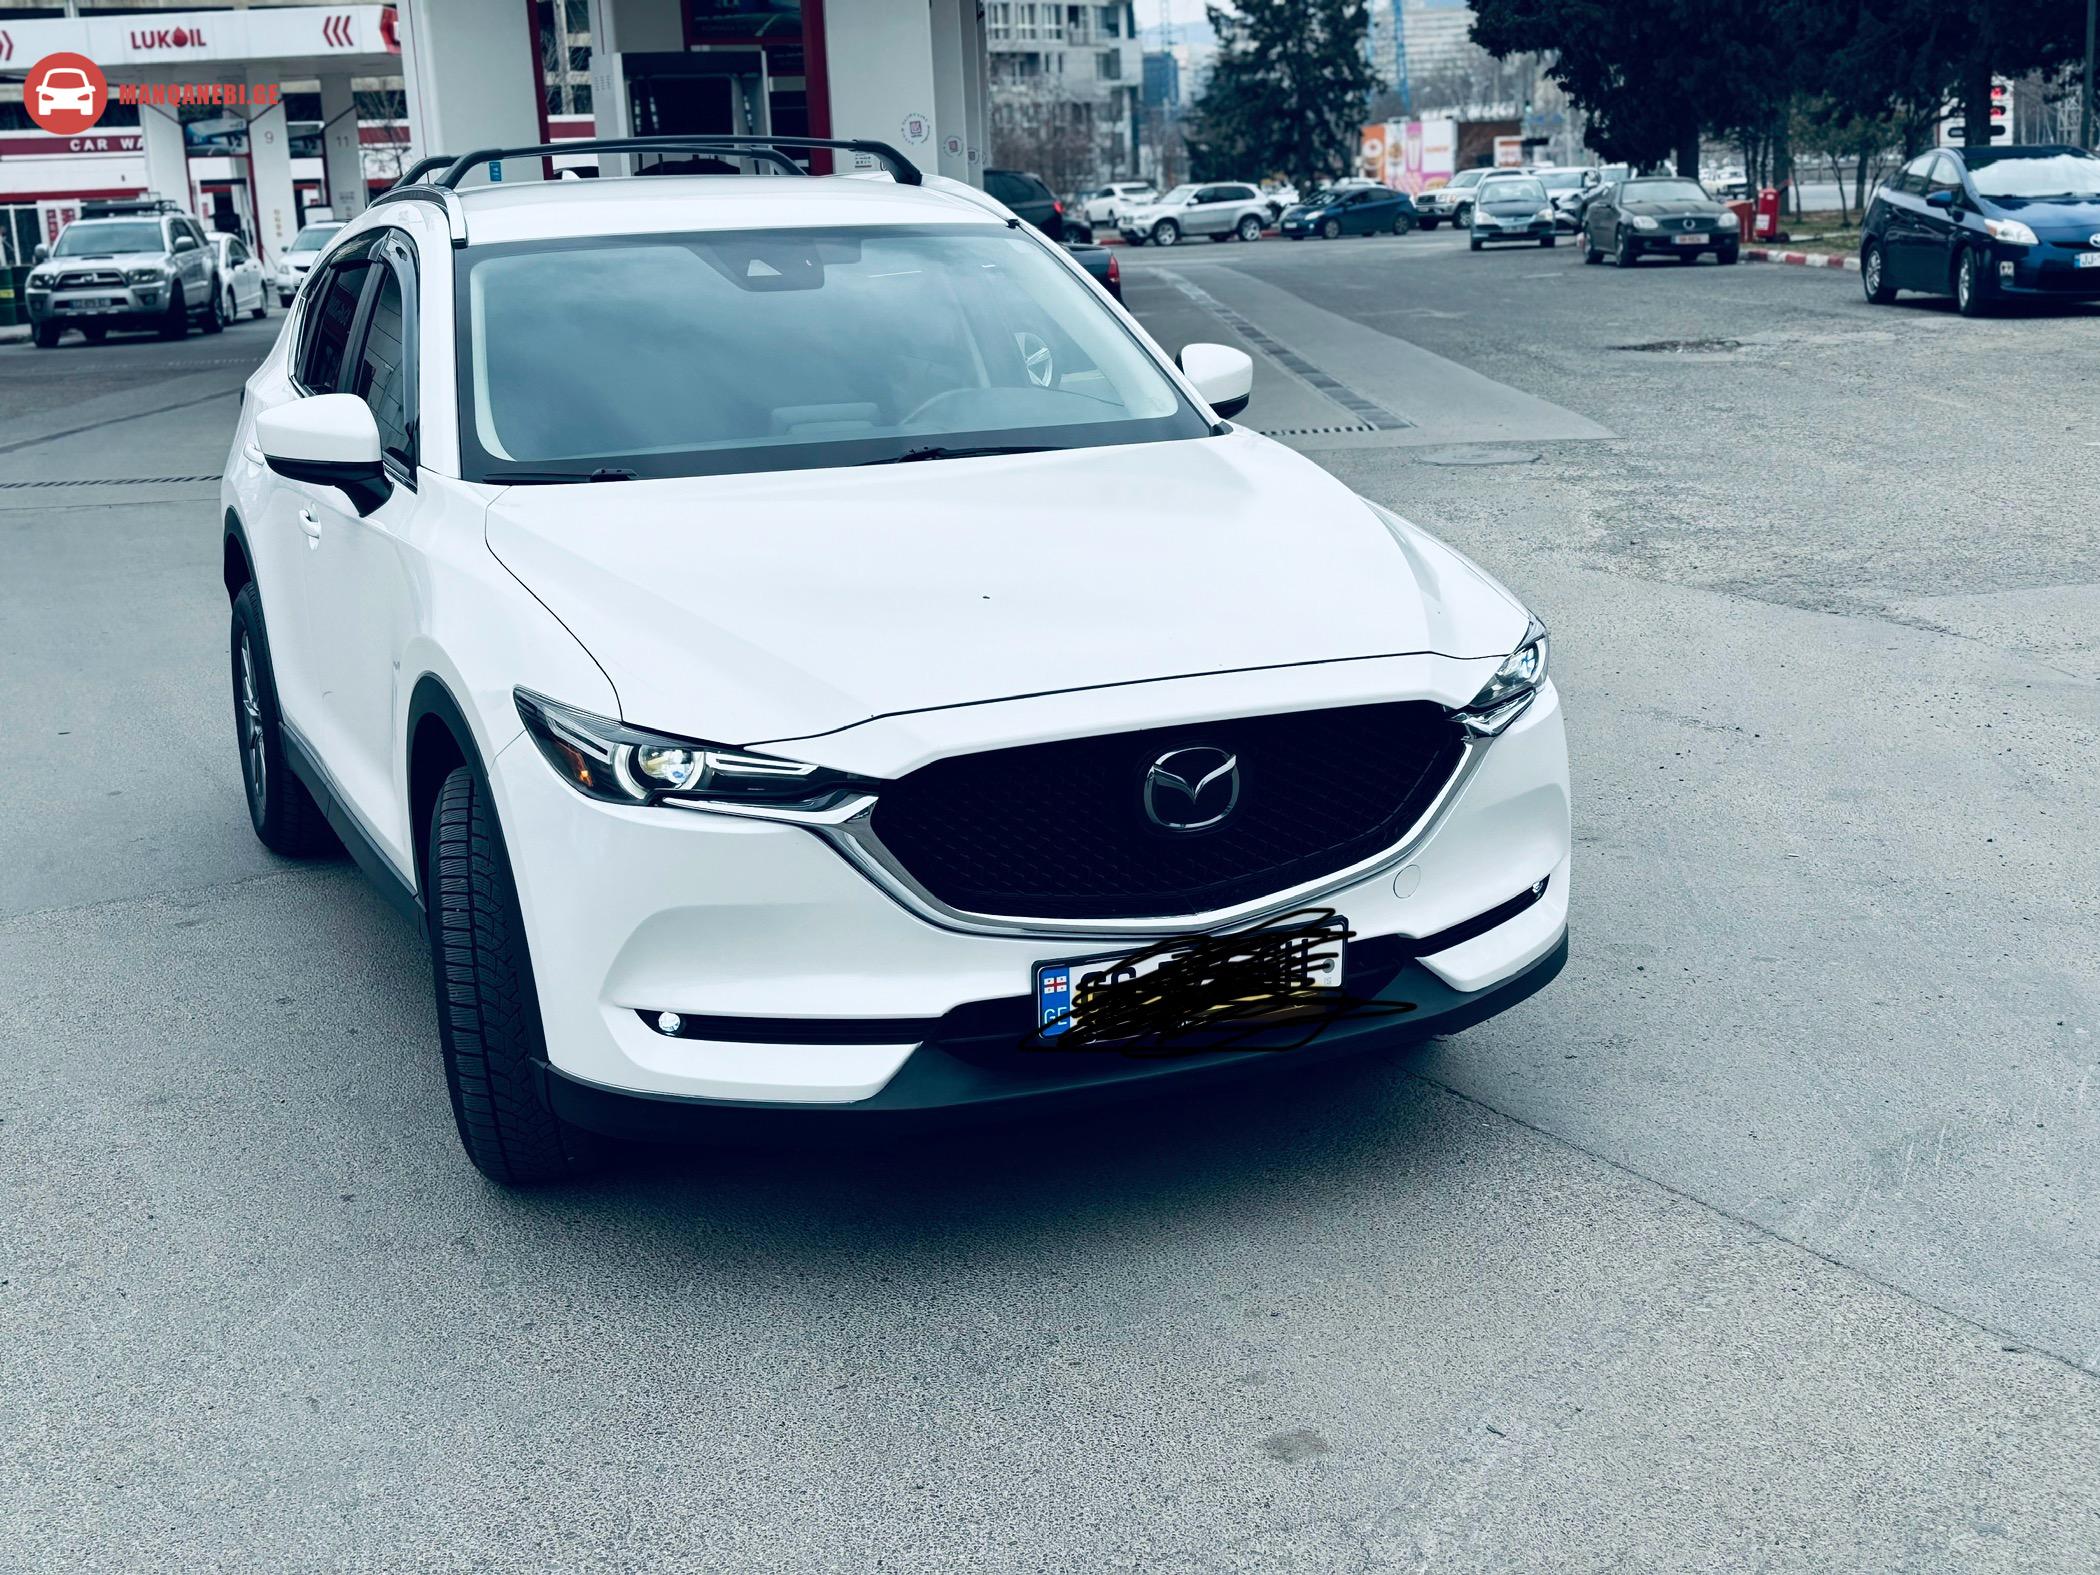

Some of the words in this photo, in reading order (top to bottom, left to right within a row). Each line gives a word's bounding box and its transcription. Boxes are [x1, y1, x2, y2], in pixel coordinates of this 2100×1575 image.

[130, 26, 207, 50] LUKOIL
[264, 130, 274, 144] 9
[336, 135, 350, 147] 11
[69, 138, 108, 152] CAR
